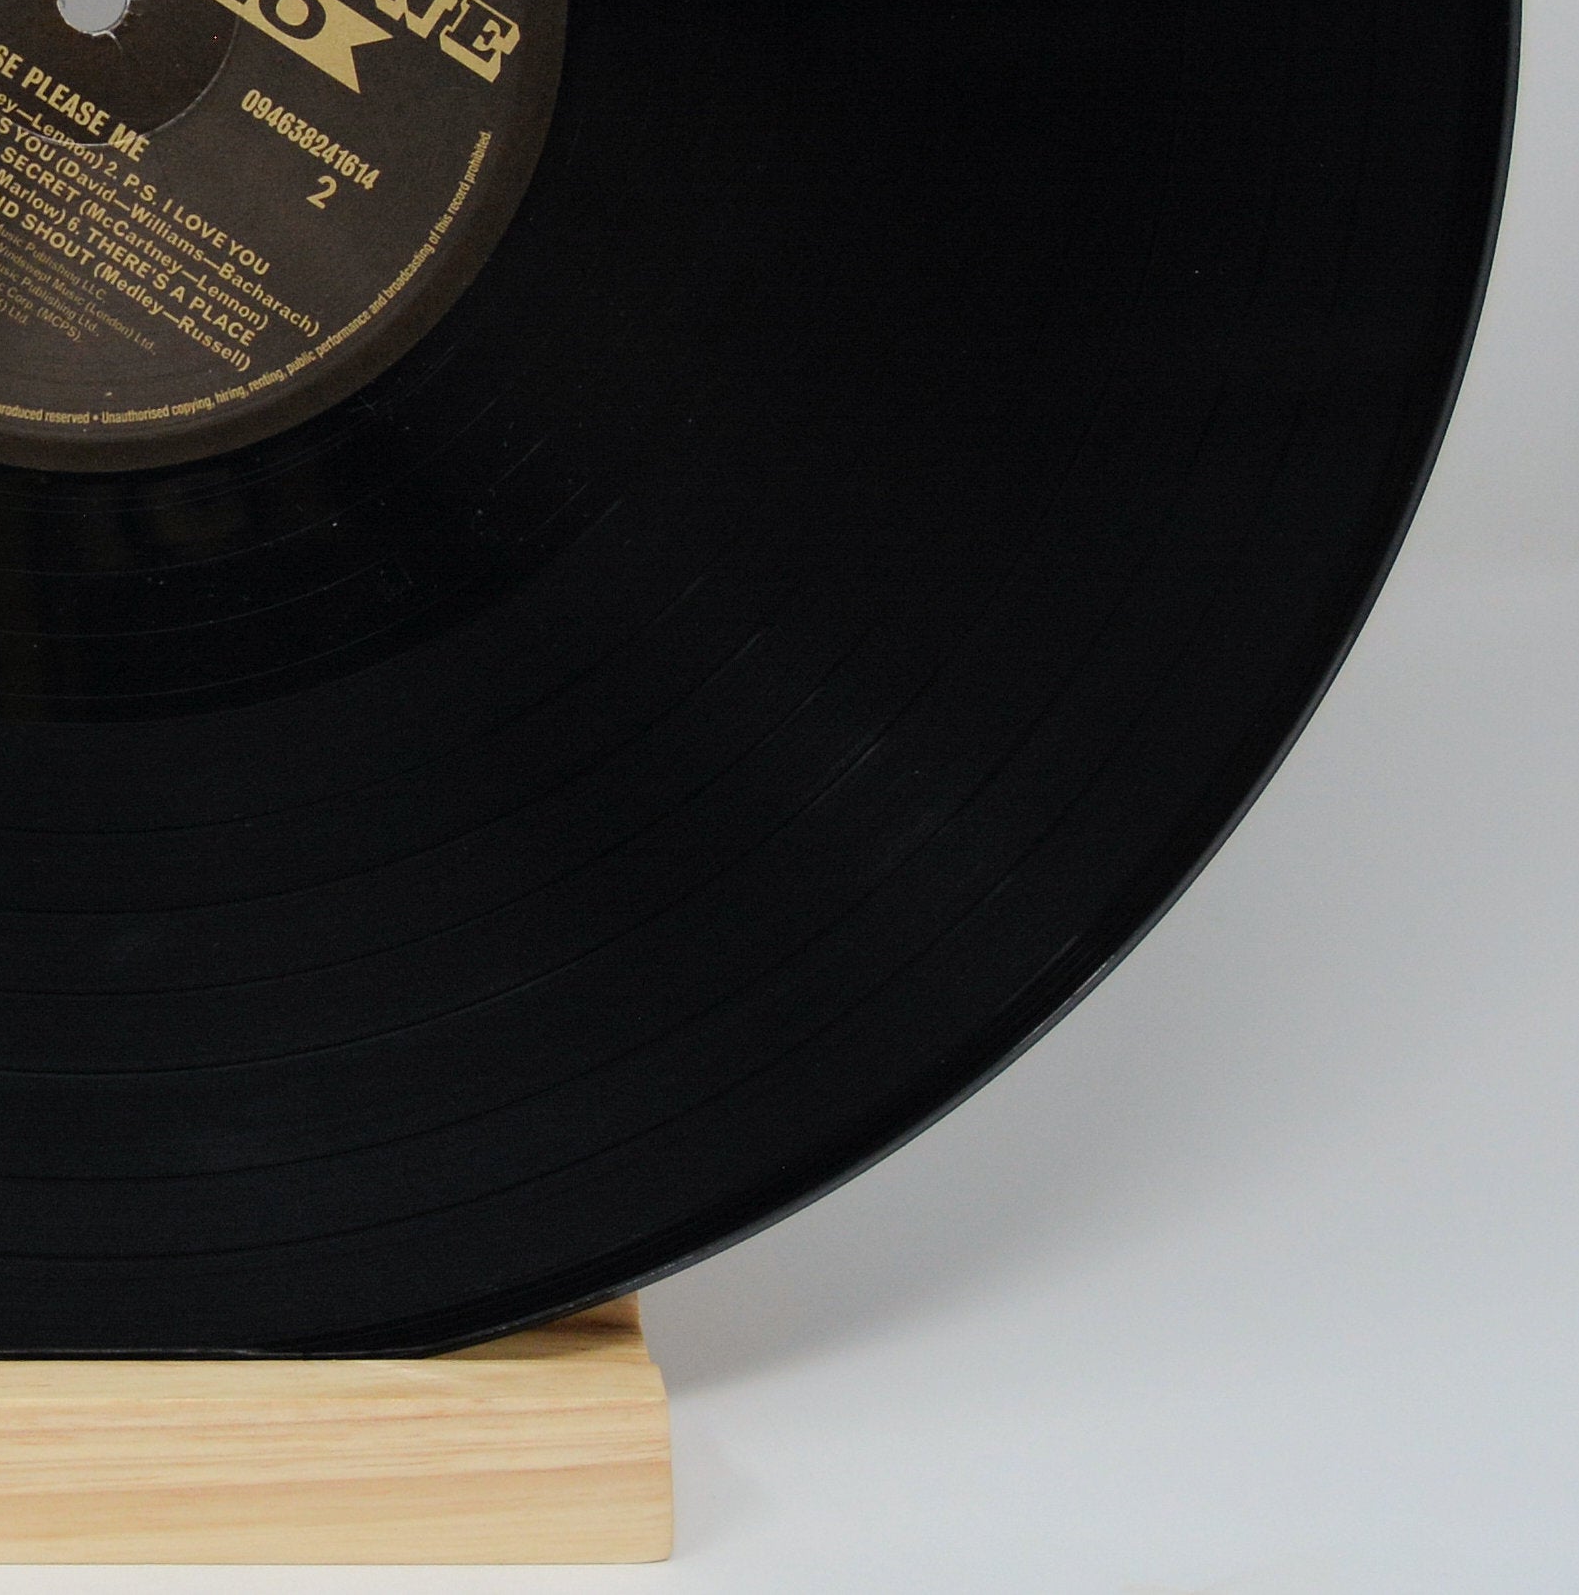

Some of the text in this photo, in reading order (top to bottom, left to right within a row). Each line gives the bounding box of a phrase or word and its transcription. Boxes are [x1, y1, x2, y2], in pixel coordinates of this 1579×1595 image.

[21, 66, 110, 135] PLEASE
[106, 123, 148, 161] ME
[14, 125, 56, 161] YOU
[241, 88, 380, 191] 094638241614
[0, 146, 81, 202] SECRET
[306, 175, 339, 211] 2
[103, 160, 117, 179] 2.
[122, 173, 156, 205] P.S.
[162, 198, 172, 212] I
[173, 205, 227, 248] LOVE
[228, 239, 269, 274] YOU
[448, 181, 471, 215] record
[20, 213, 95, 265] SHOUT
[428, 230, 441, 245] of
[433, 213, 454, 234] this
[24, 241, 81, 285] Publishing
[67, 216, 80, 235] 6.
[87, 226, 169, 289] THERE'S
[169, 285, 185, 302] A
[188, 295, 255, 346] PLACE
[382, 243, 436, 299] broadcasting
[20, 276, 76, 320] Publishing
[51, 277, 84, 305] Music
[84, 301, 134, 338] (London)
[368, 292, 388, 315] and
[315, 310, 372, 359] performance
[286, 350, 317, 377] public
[45, 409, 89, 424] reserved
[101, 405, 169, 424] Unauthorised
